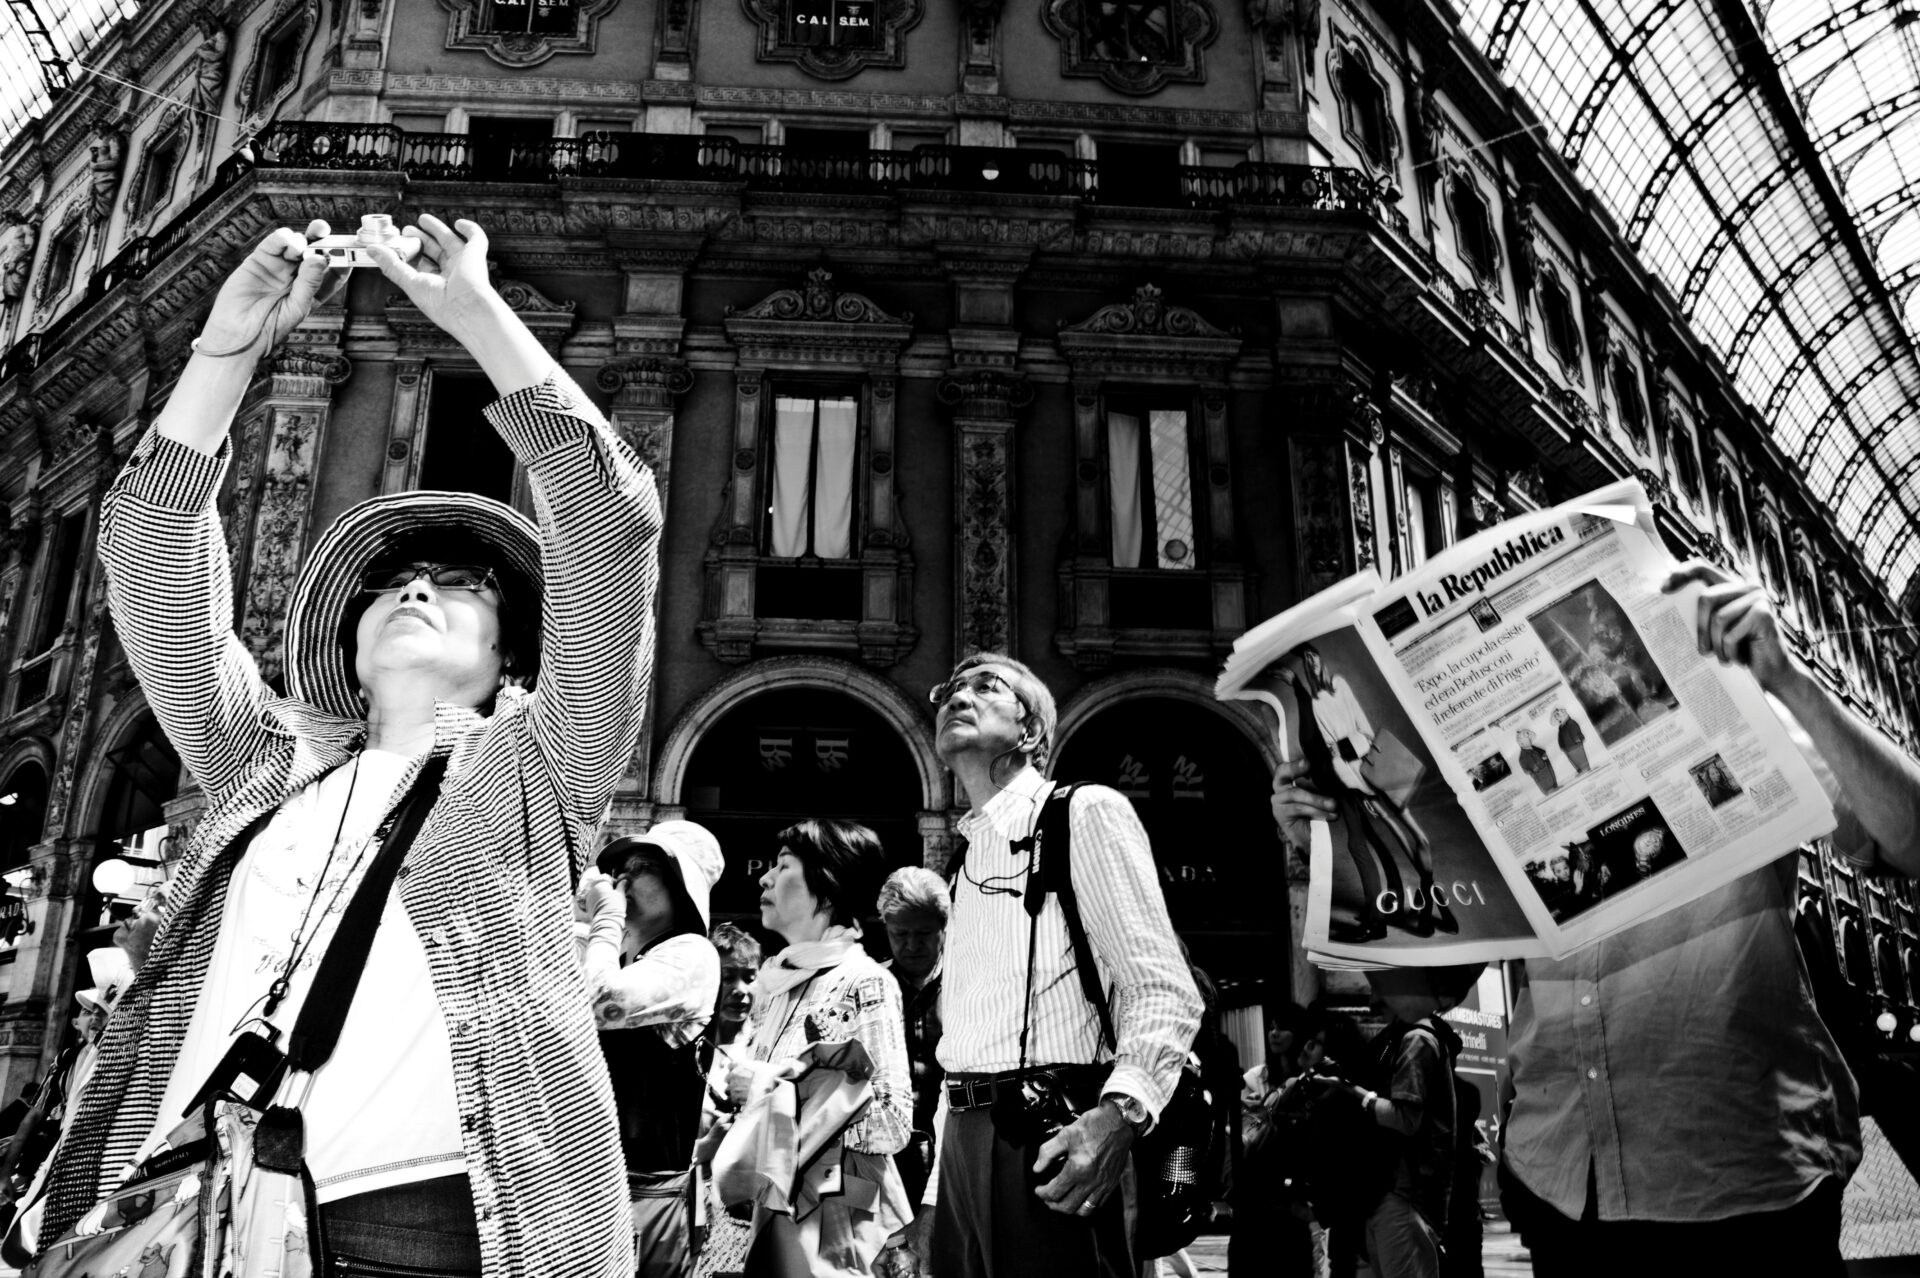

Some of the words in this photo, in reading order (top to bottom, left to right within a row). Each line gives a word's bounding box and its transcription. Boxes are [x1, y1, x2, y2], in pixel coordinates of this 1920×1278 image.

[1414, 590, 1445, 617] la
[1438, 524, 1565, 603] Repubblica
[1459, 641, 1497, 667] cupola
[1497, 623, 1527, 645] esiste
[1453, 650, 1513, 691] Berlusconi
[1440, 689, 1487, 721] referente
[1599, 806, 1645, 836] LONGINES
[1376, 881, 1485, 914] GUCCI
